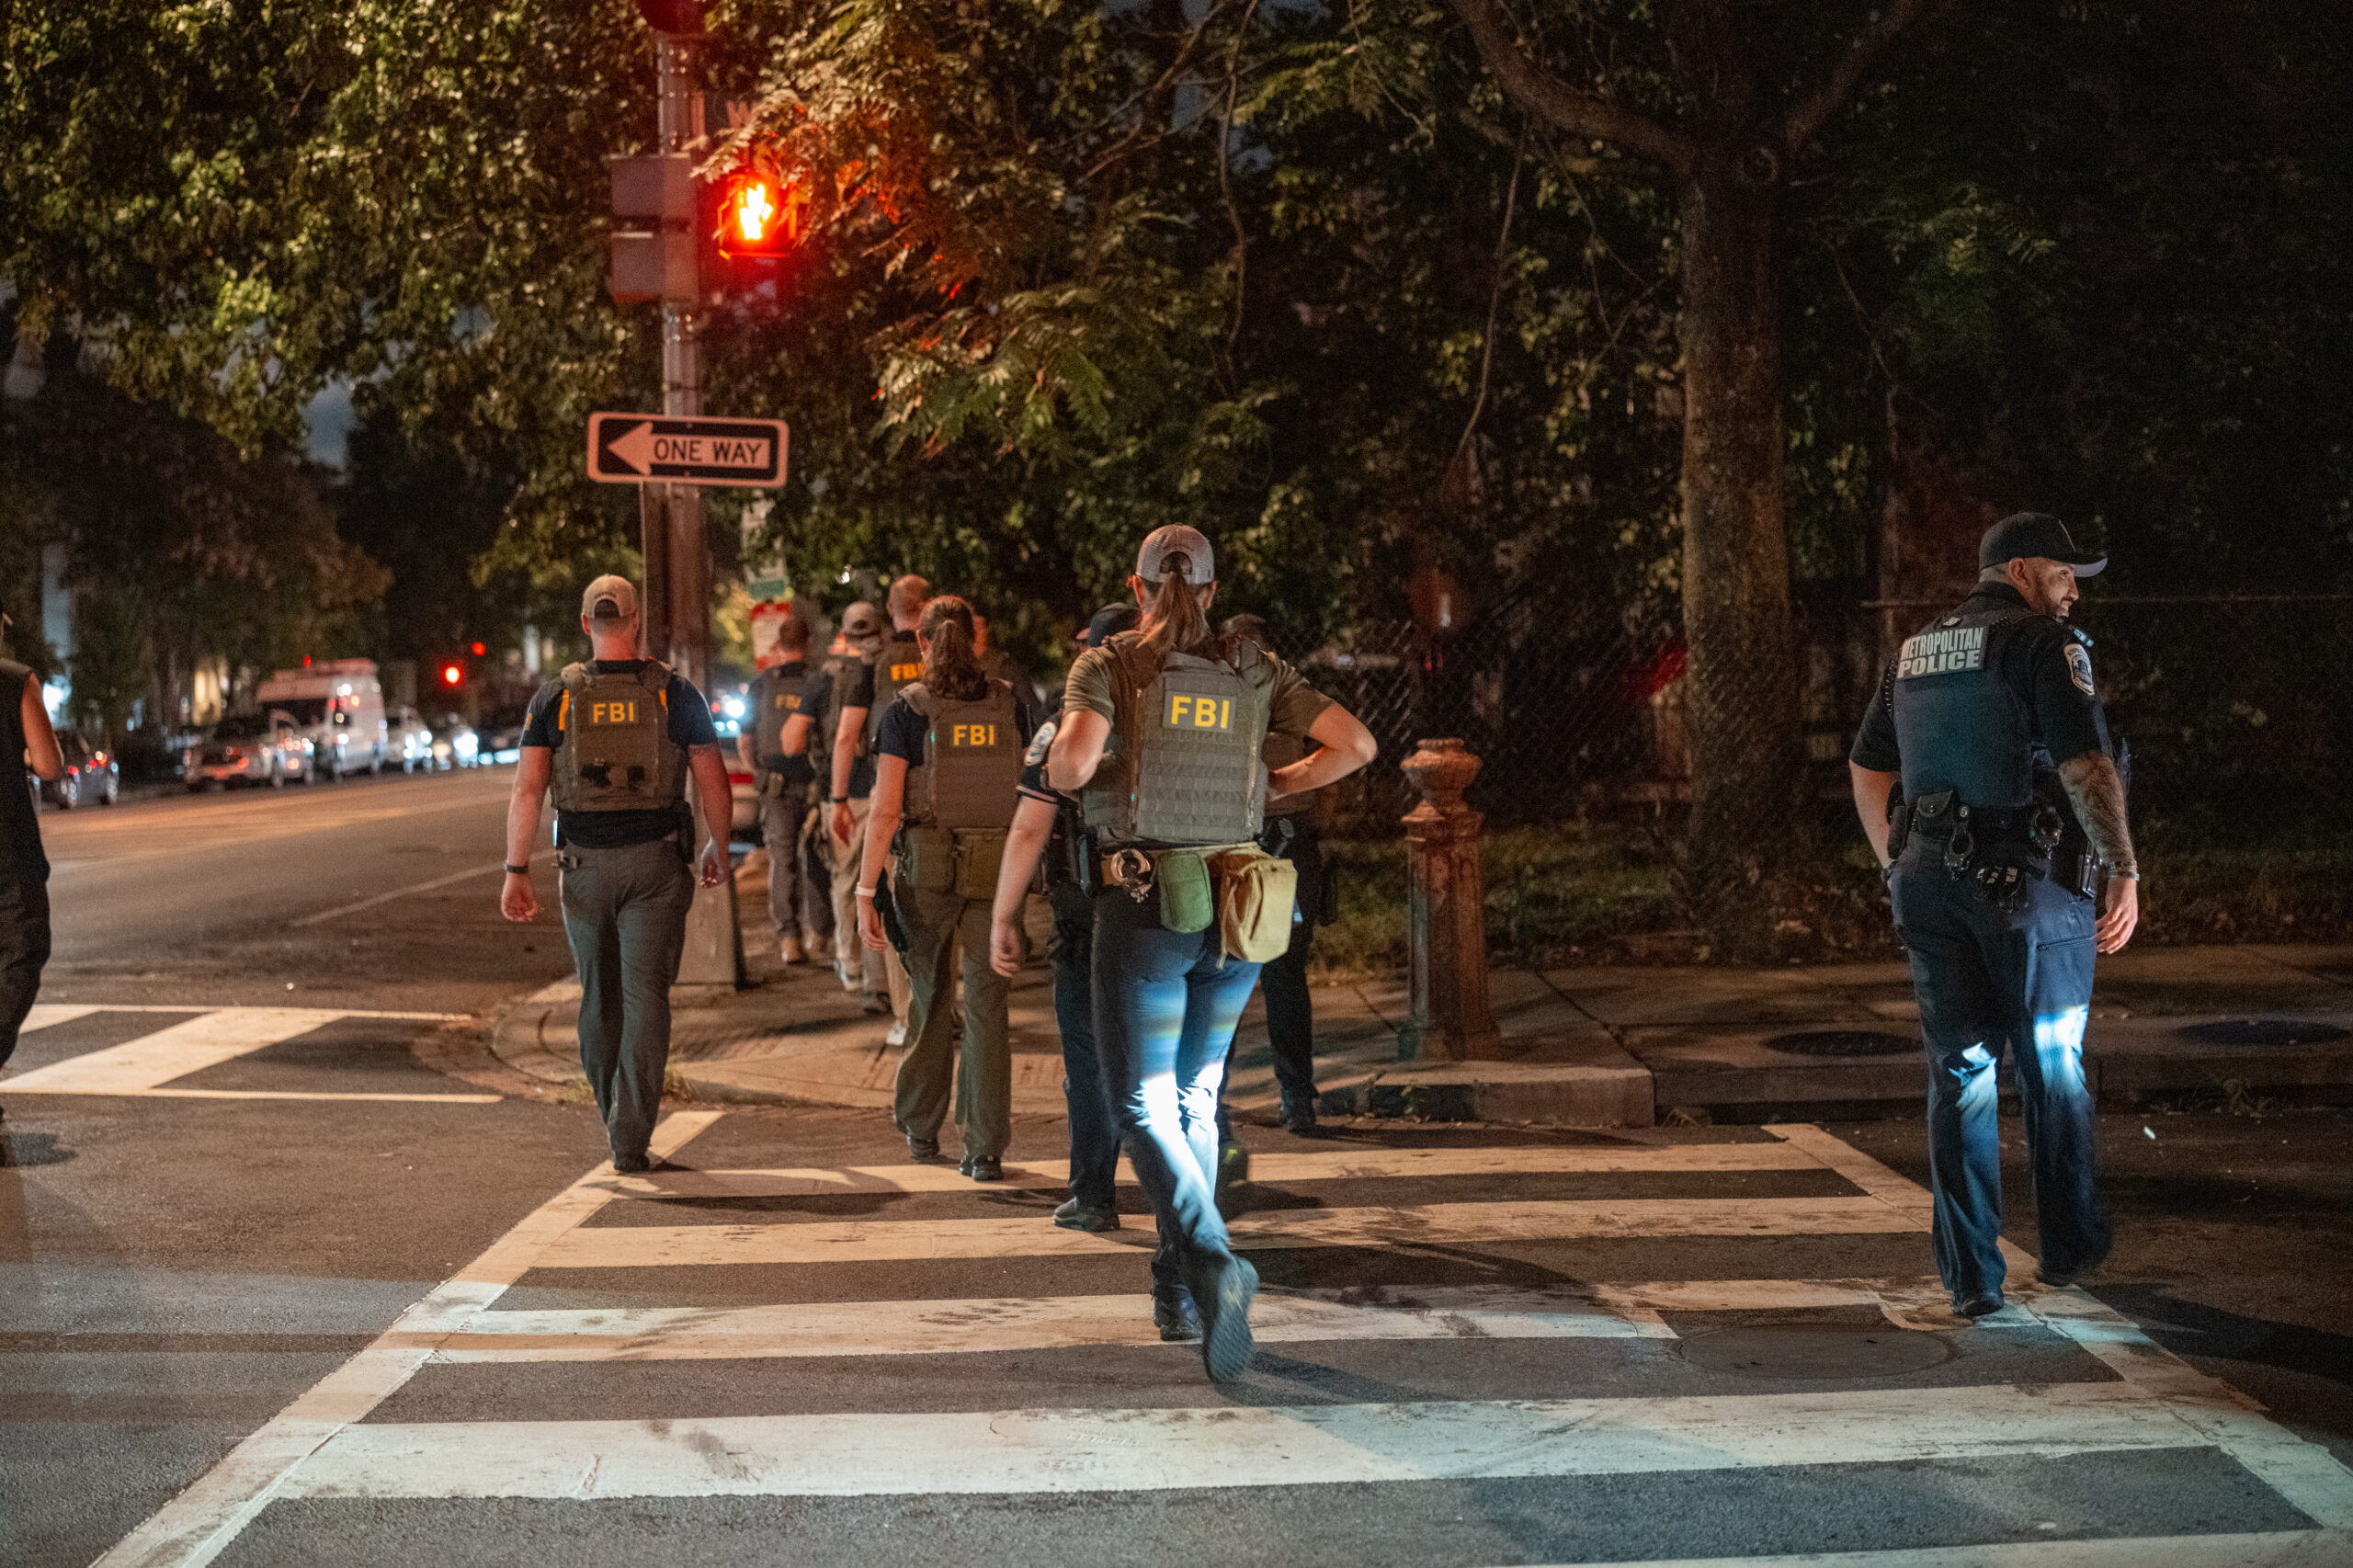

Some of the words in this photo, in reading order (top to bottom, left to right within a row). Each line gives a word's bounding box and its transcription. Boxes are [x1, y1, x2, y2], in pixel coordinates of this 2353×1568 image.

[654, 438, 702, 461] ONE
[712, 440, 762, 463] WAY
[1900, 626, 1984, 661] METROPOLITAN
[1896, 649, 1981, 678] POLICE
[592, 701, 635, 723] FBI
[1170, 696, 1230, 729] FBI
[953, 724, 995, 746] FBI
